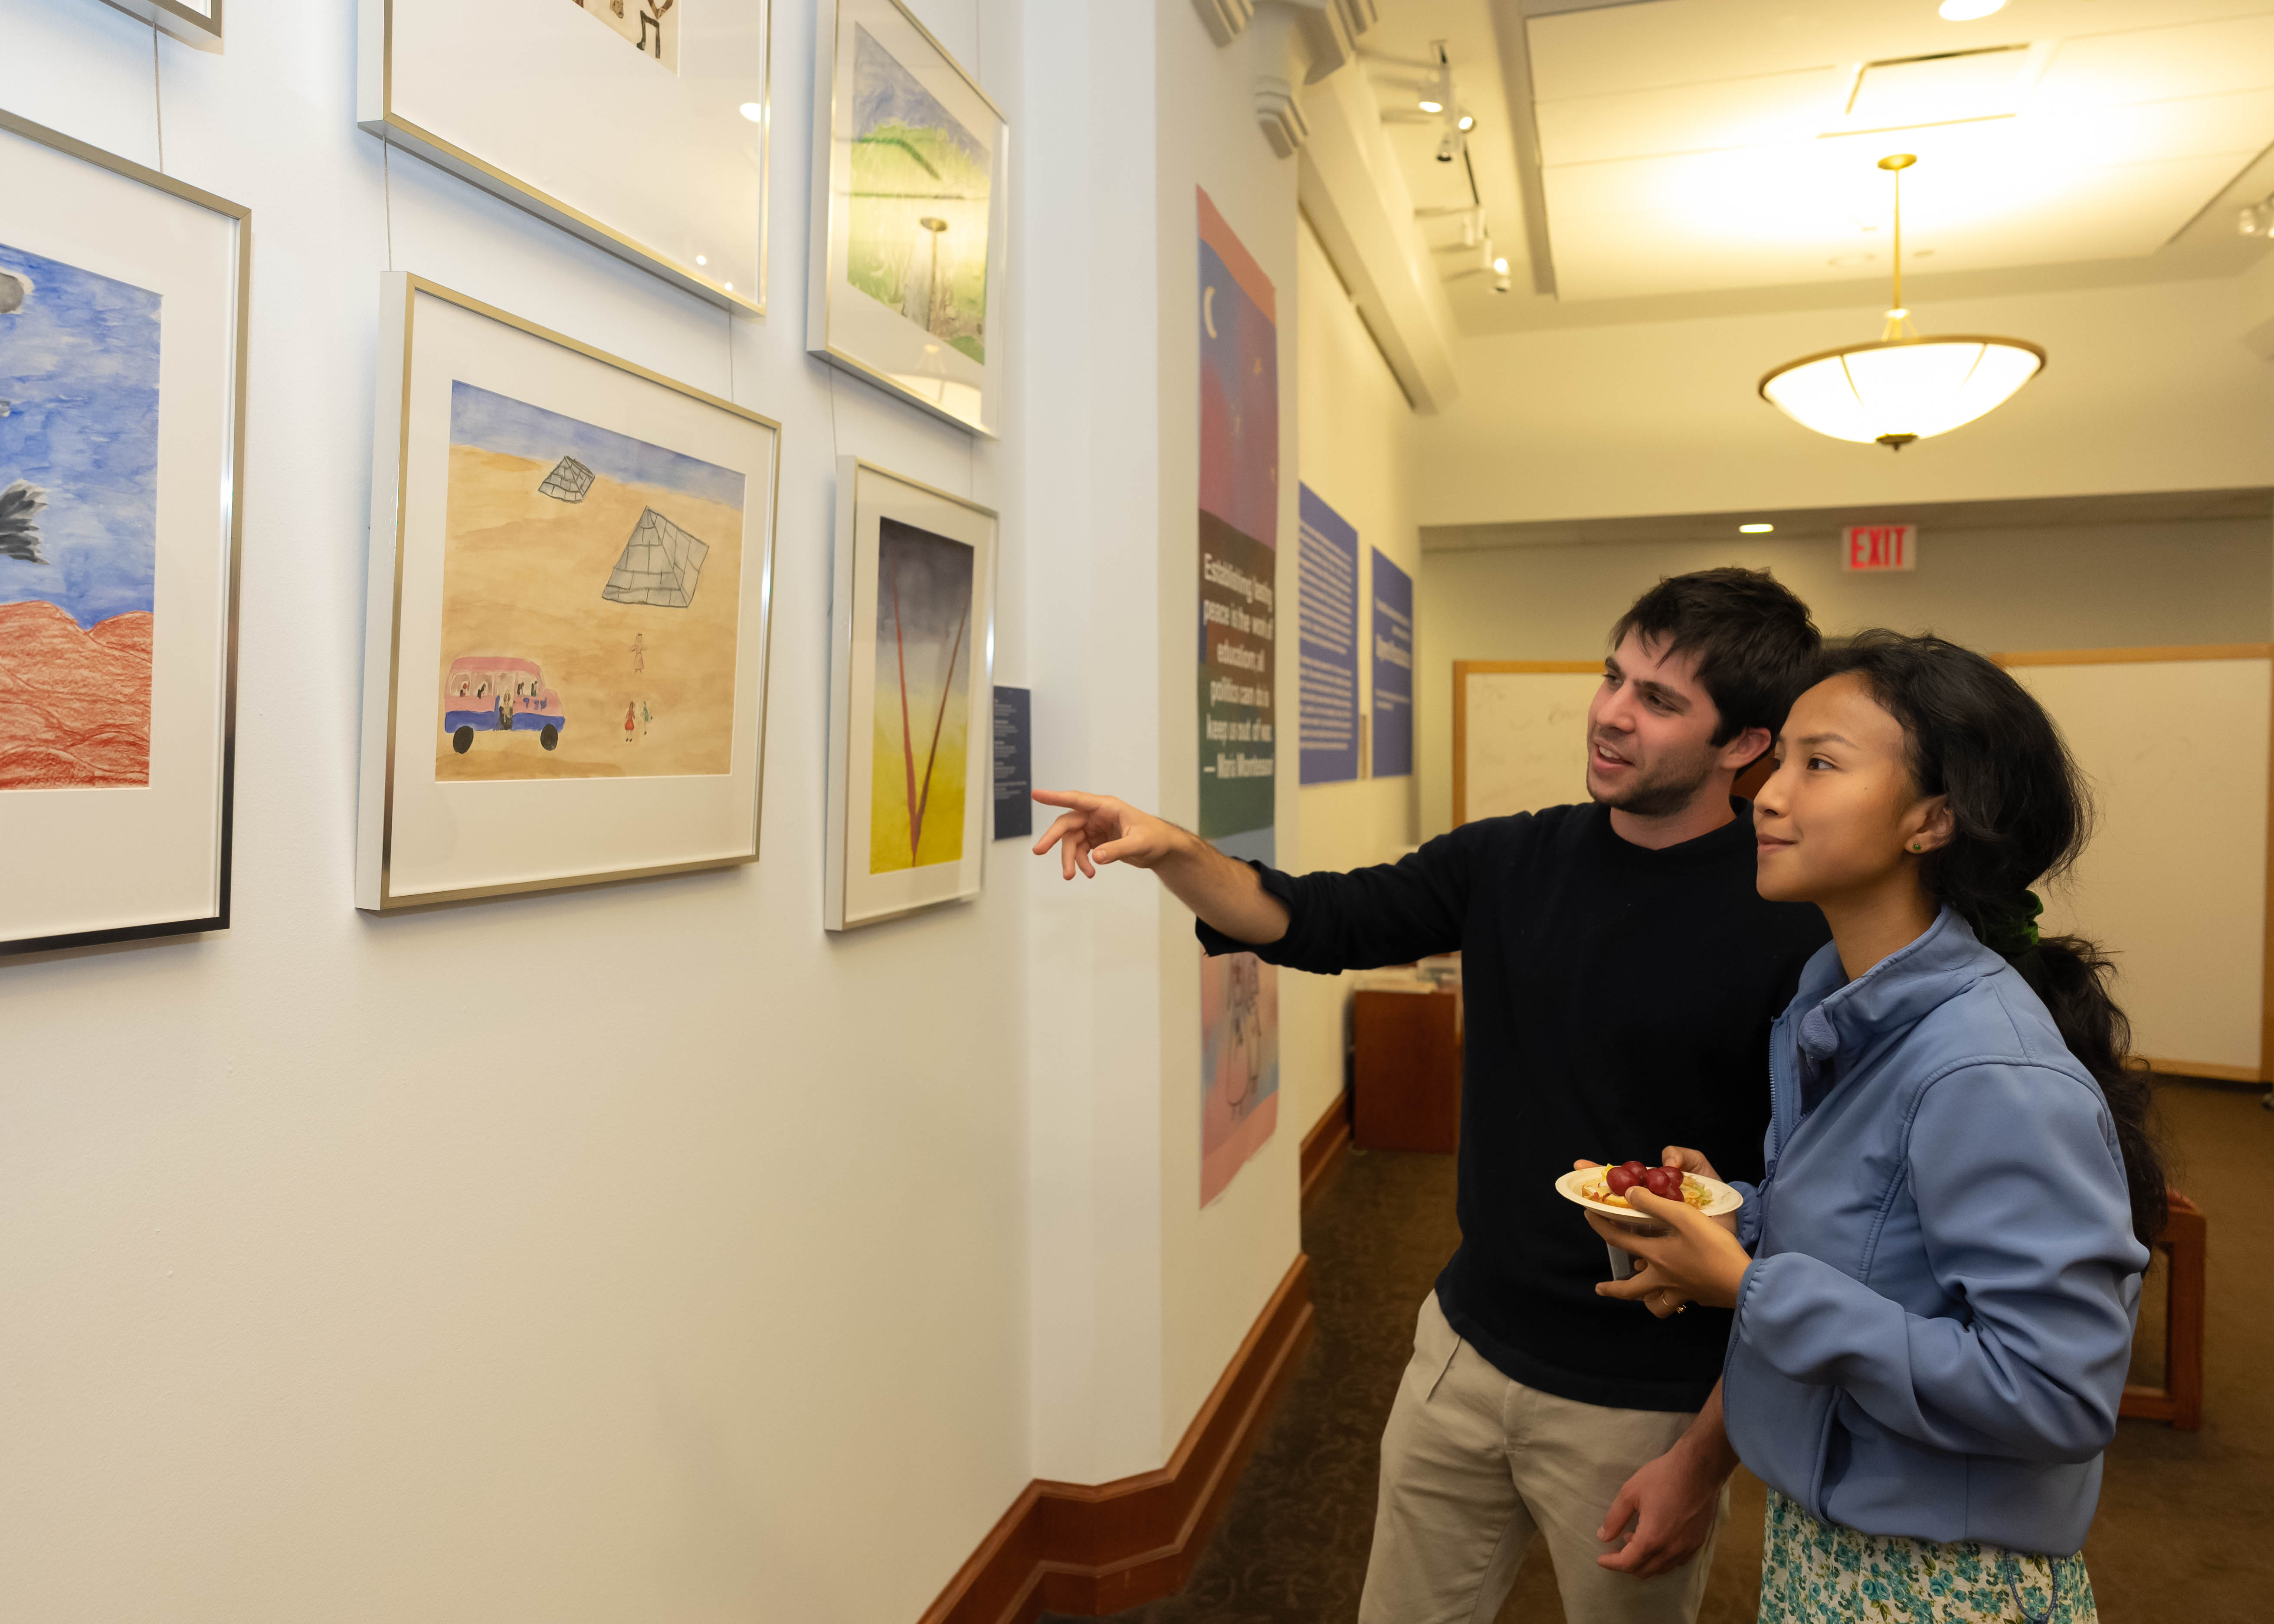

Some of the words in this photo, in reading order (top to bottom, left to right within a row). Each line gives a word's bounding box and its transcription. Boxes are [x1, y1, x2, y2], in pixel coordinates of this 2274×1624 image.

[1851, 527, 1907, 568] EXIT
[1203, 599, 1229, 625] peace
[1210, 676, 1239, 707] politics
[1206, 713, 1228, 747] keep
